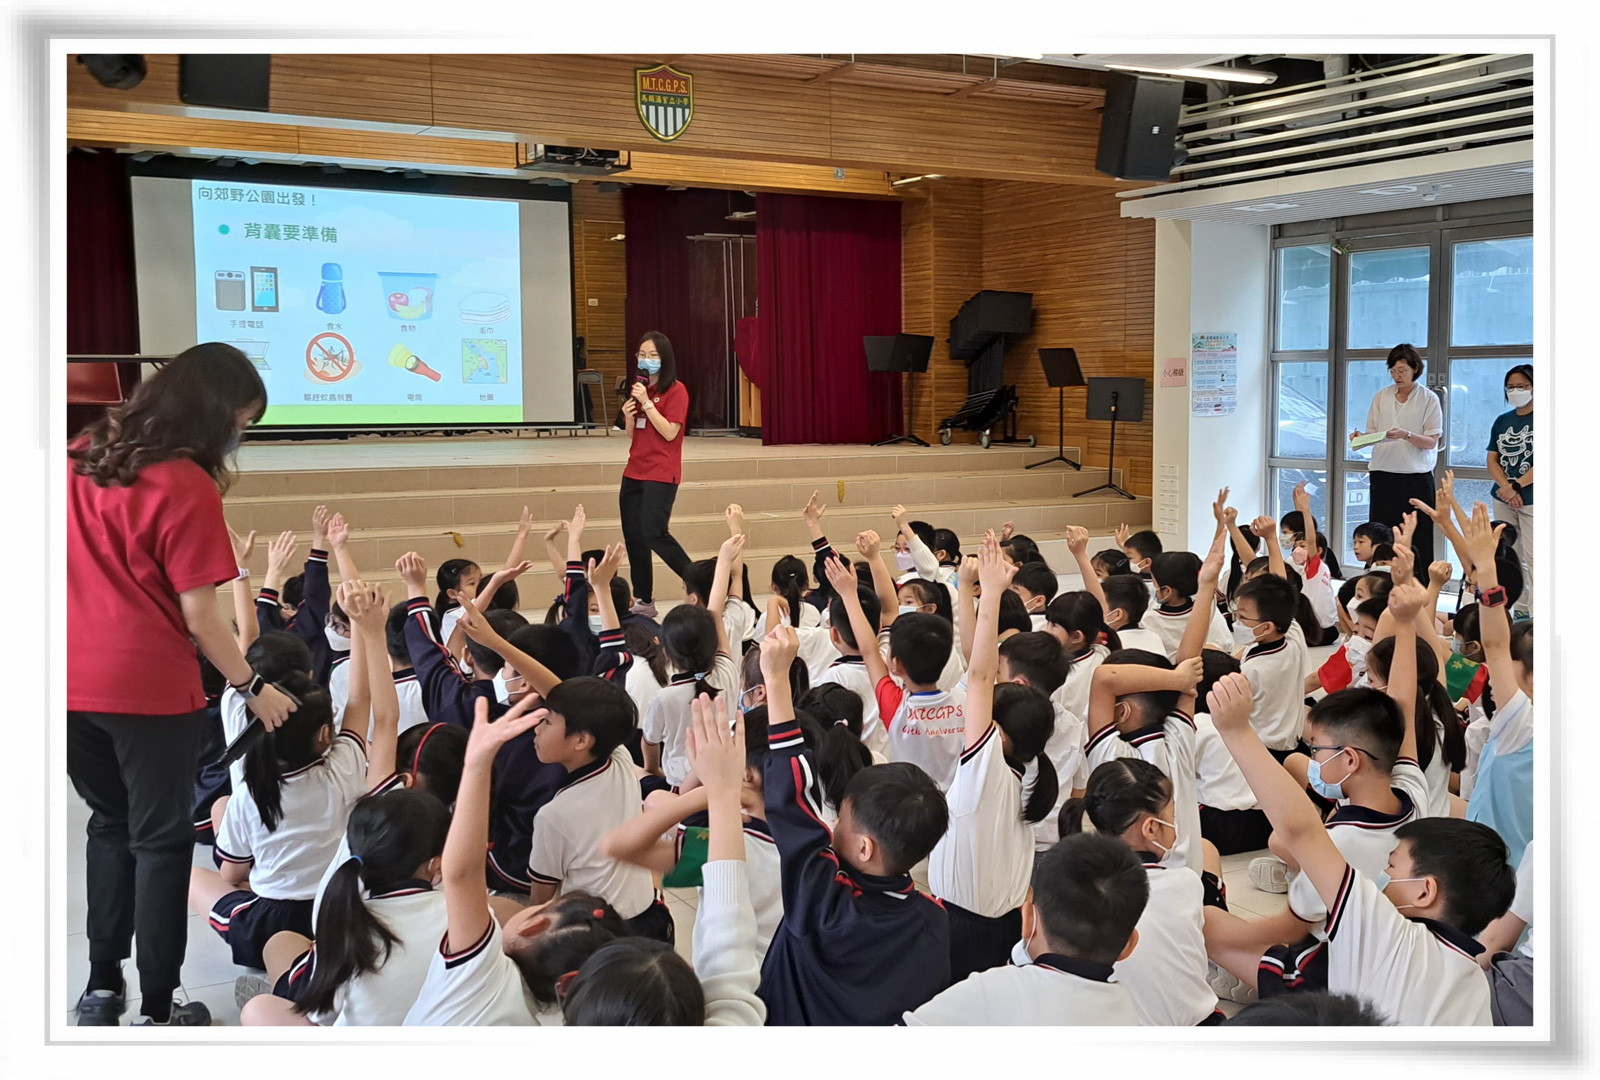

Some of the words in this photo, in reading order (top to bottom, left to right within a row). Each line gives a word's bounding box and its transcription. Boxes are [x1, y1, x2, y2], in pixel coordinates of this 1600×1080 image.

[642, 77, 688, 93] M.T.C.G.P.S.
[244, 222, 337, 243] 背囊要準備
[230, 320, 264, 329] 手提電話
[326, 322, 343, 331] 食水
[400, 324, 416, 333] 食物
[479, 326, 494, 335] 毛巾
[1348, 492, 1363, 504] LD
